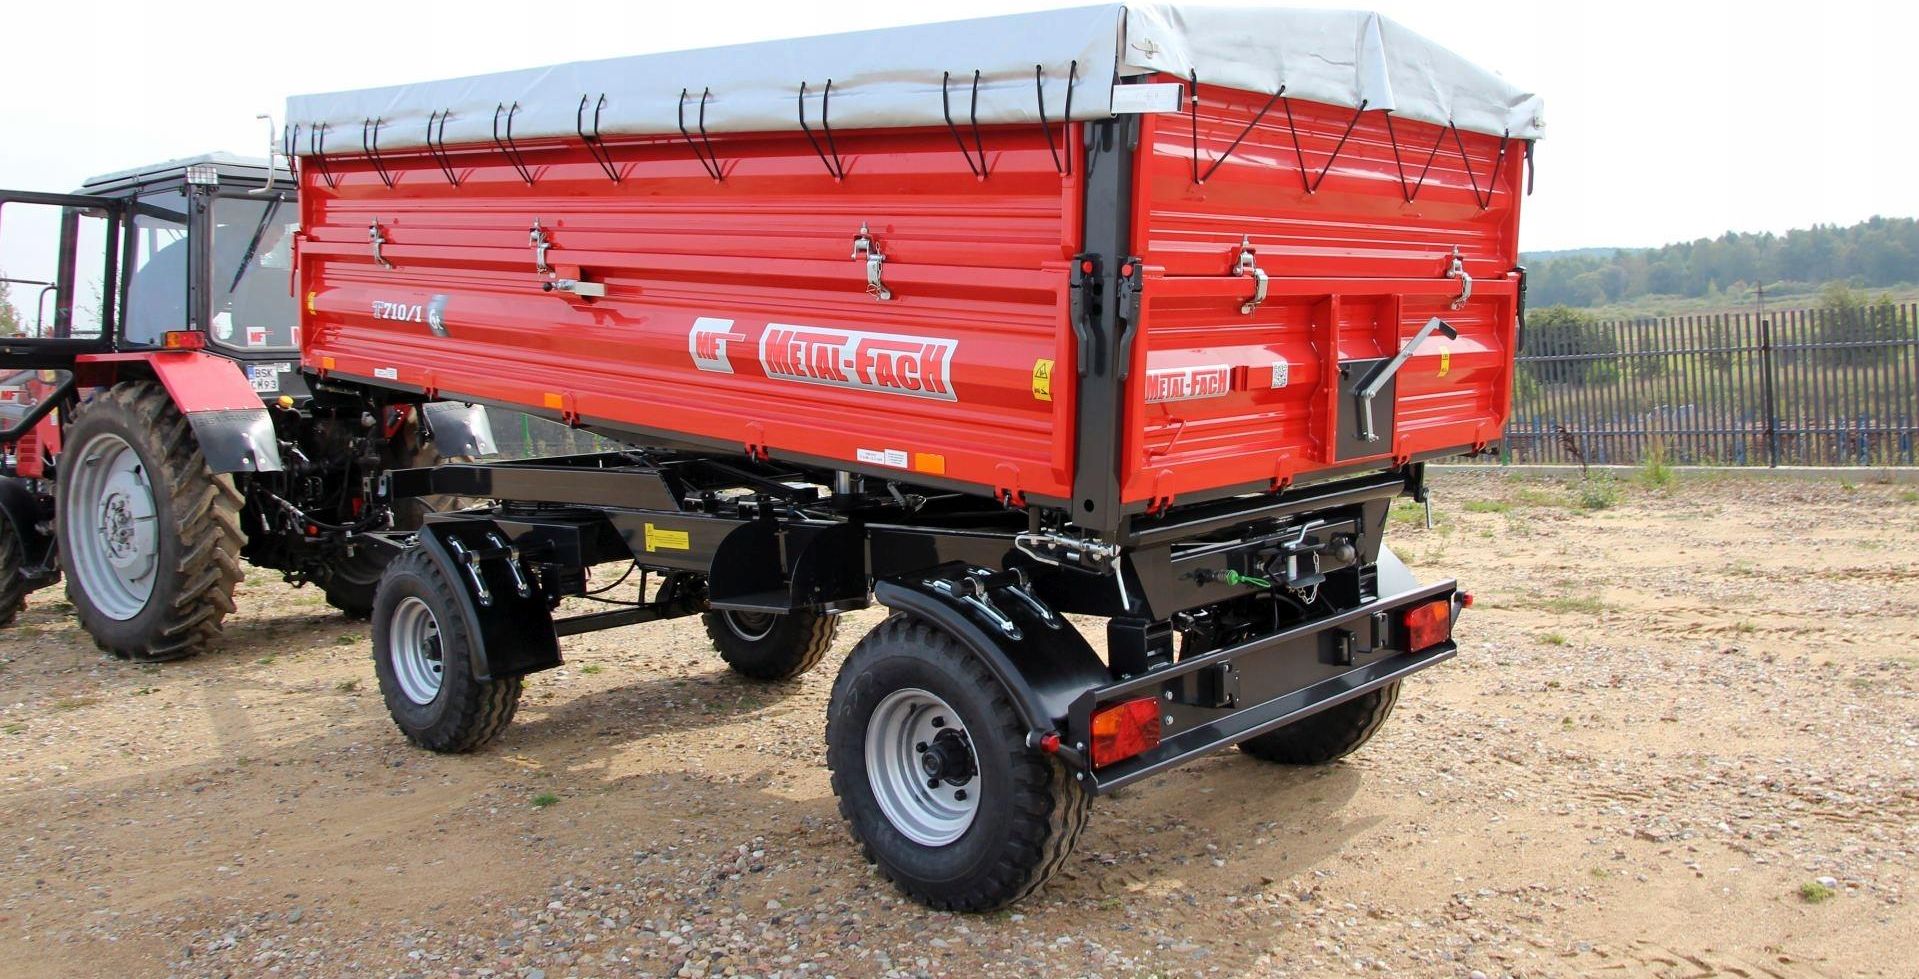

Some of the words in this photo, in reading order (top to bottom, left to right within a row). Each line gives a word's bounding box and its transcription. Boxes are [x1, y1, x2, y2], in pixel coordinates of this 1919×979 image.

[371, 300, 422, 323] T710/1
[696, 330, 745, 361] MF
[765, 329, 948, 393] METAL-FACH
[255, 369, 273, 378] BSK
[1145, 368, 1228, 400] METAL-FACH
